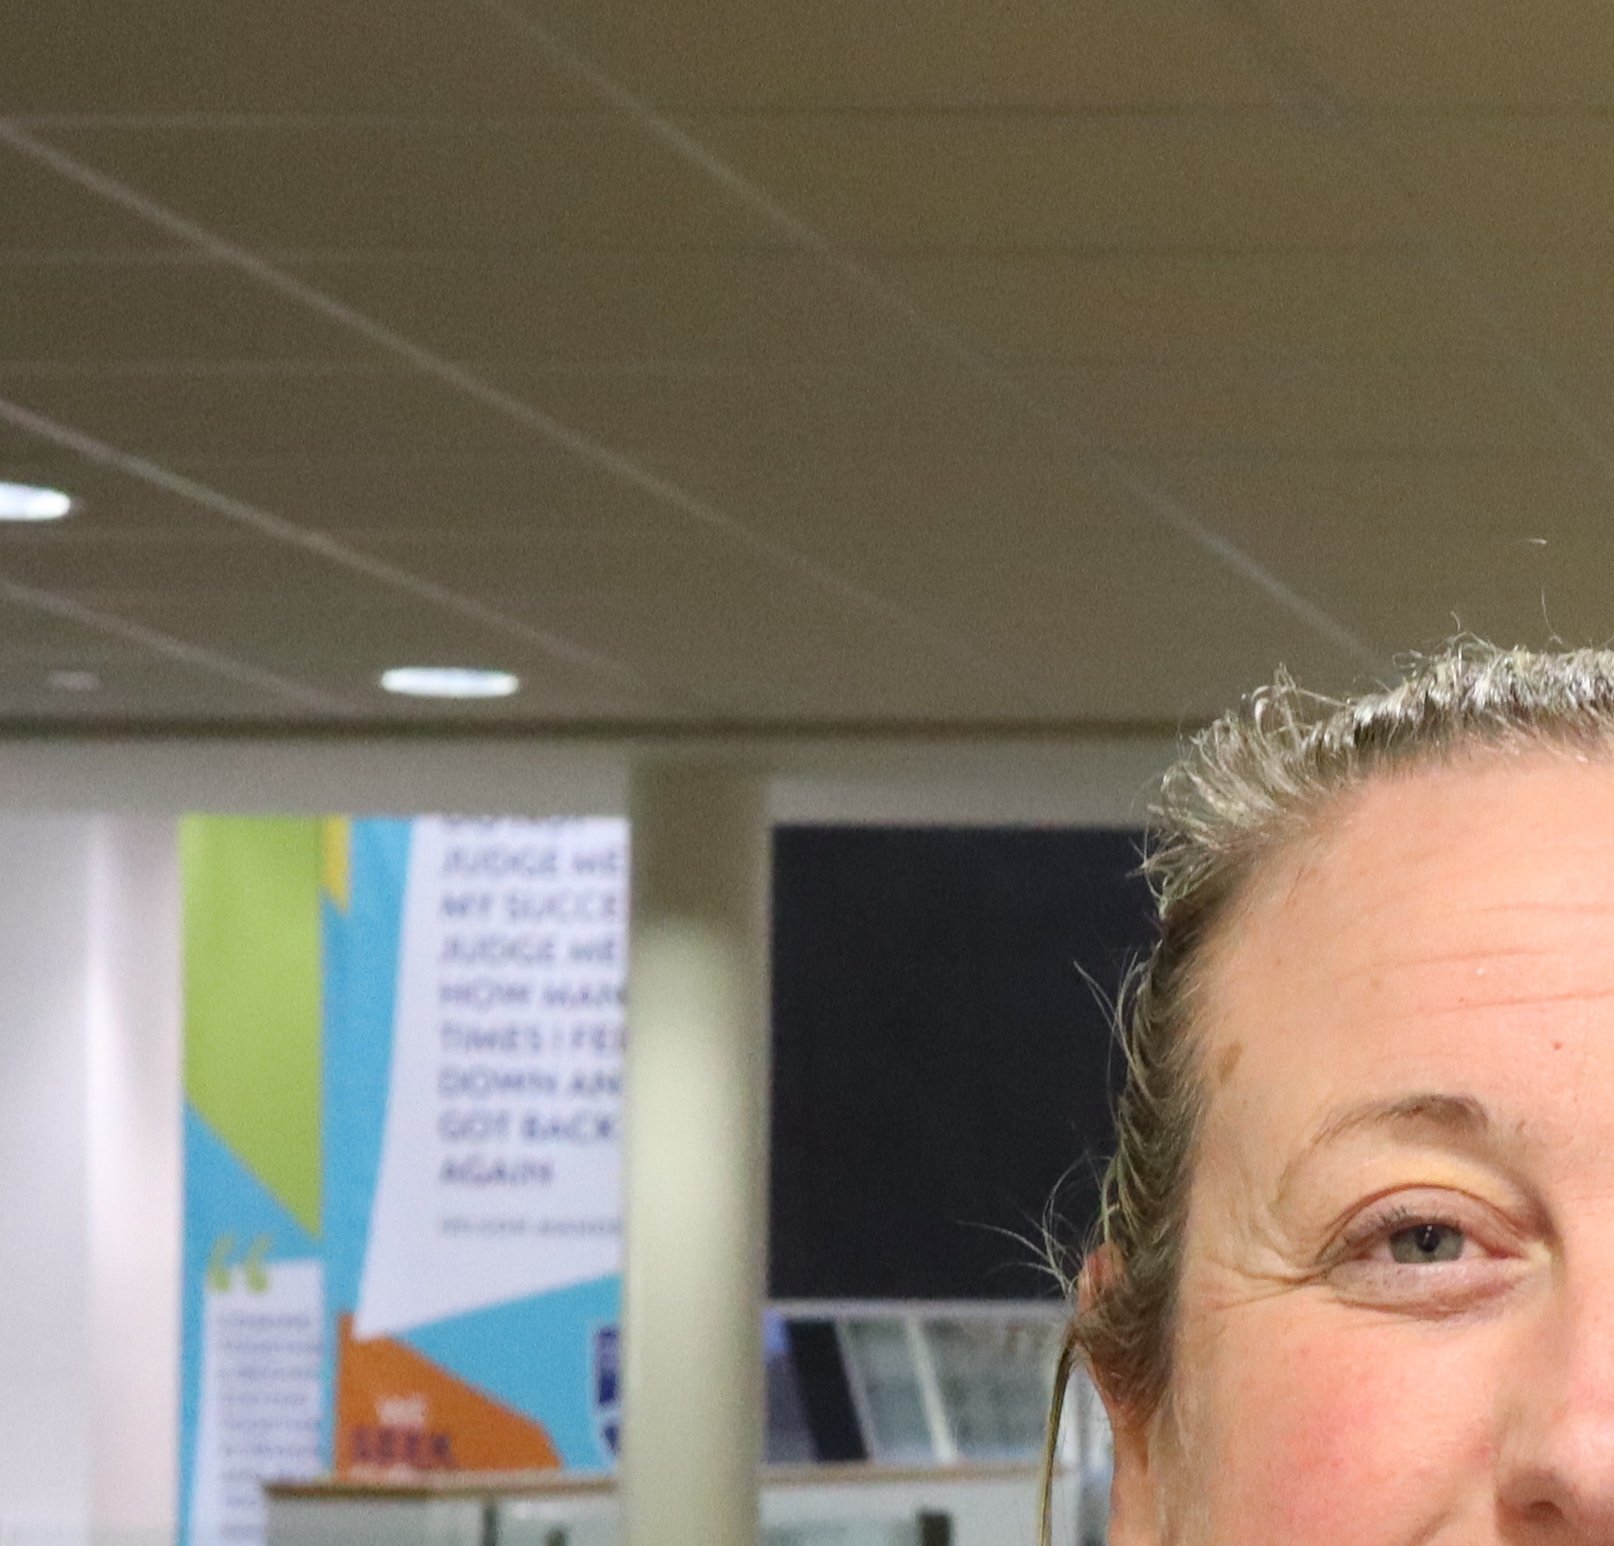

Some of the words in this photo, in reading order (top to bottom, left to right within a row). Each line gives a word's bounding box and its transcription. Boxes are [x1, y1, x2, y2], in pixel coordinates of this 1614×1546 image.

[441, 847, 558, 875] JUDGE
[441, 935, 556, 963] JUDGE
[438, 981, 530, 1008] HOW
[438, 1111, 509, 1141] GOT
[521, 1111, 616, 1141] BACK
[439, 1156, 553, 1186] AGAIN
